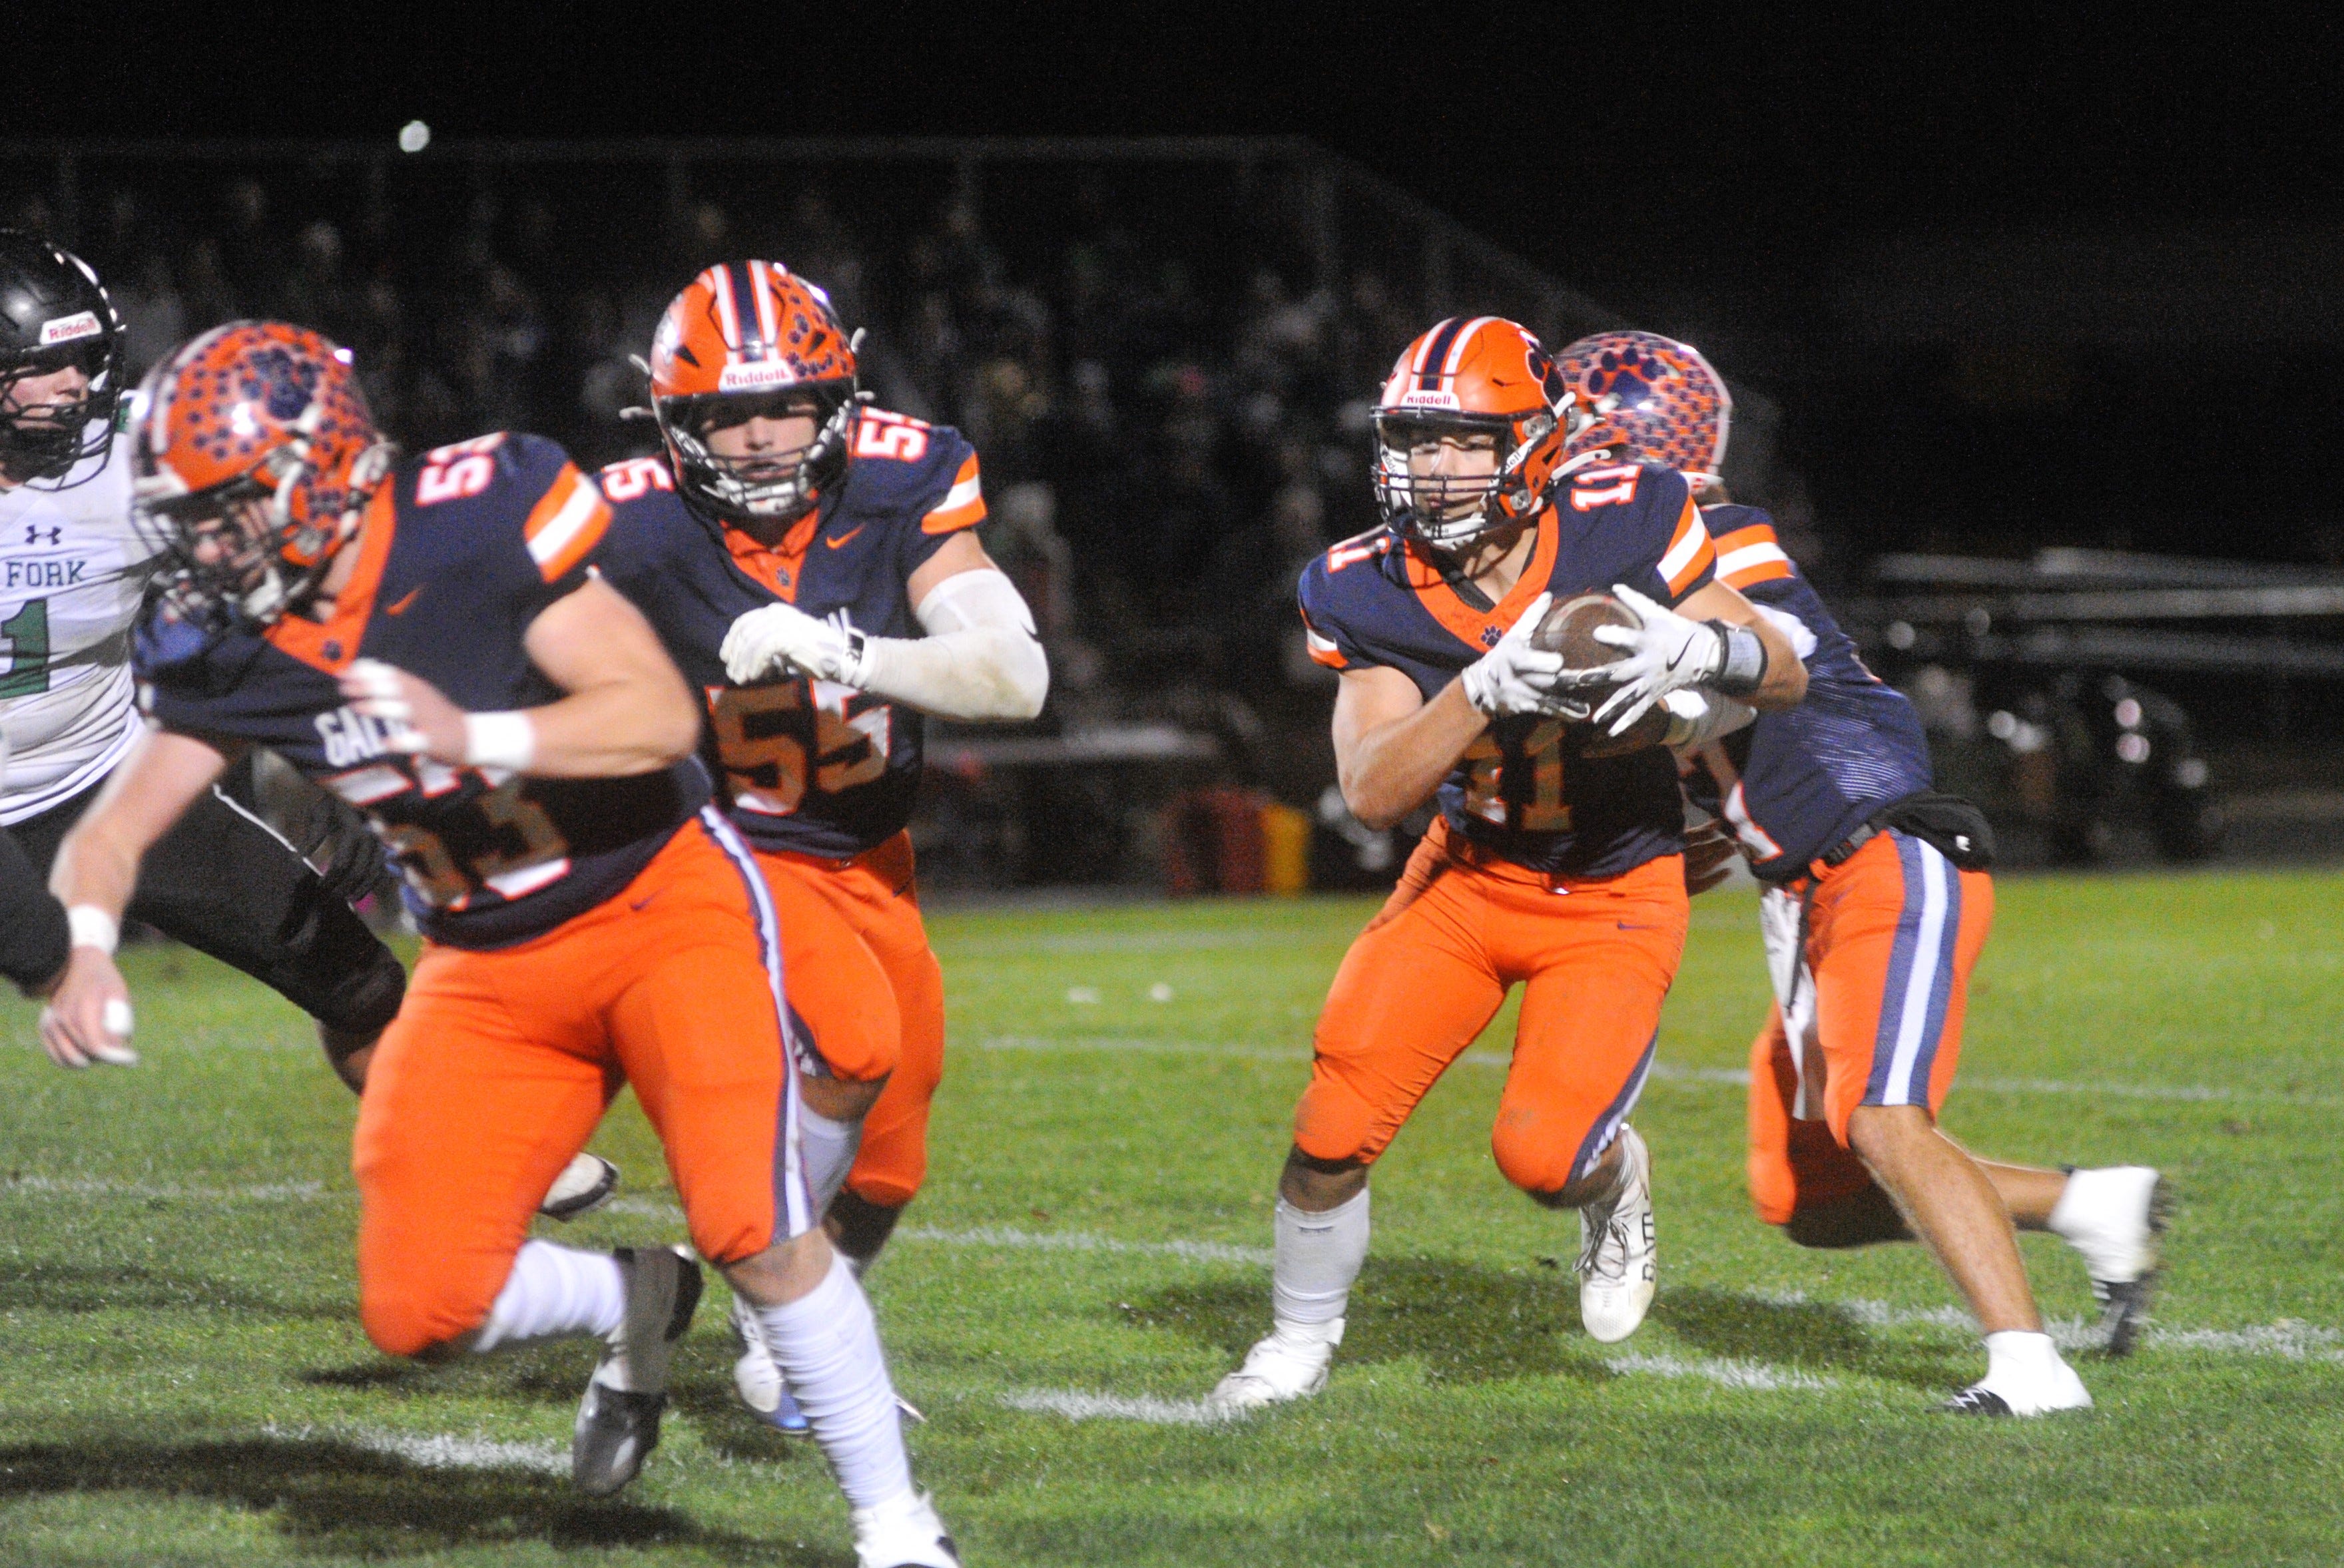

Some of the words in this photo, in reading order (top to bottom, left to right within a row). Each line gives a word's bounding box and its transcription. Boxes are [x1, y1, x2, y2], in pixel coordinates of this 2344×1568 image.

[49, 318, 96, 340] Riddell
[726, 368, 786, 385] Riddell
[1406, 394, 1451, 405] Riddell
[601, 457, 675, 503] 5
[1570, 464, 1643, 512] 11
[5, 560, 87, 587] FORK
[704, 677, 891, 817] 55
